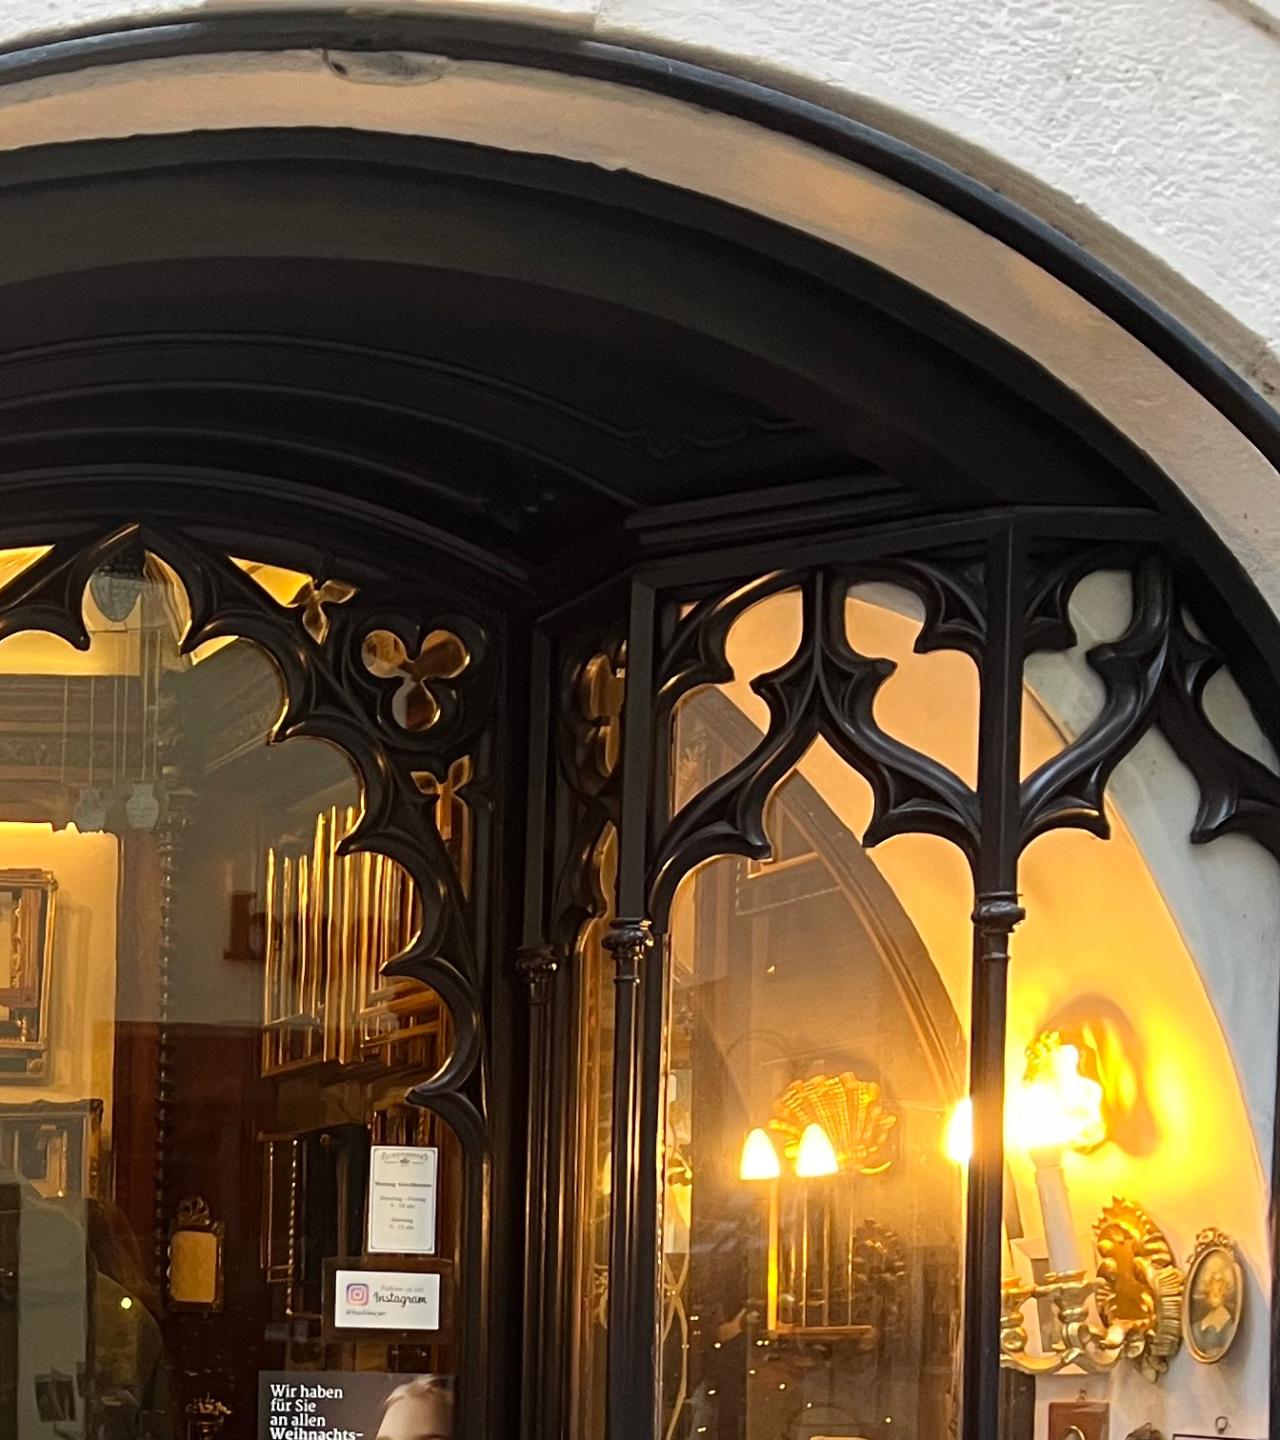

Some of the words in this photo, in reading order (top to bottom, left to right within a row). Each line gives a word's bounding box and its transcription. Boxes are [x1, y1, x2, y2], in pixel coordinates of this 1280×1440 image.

[373, 1292, 427, 1308] Instagram
[270, 1384, 297, 1398] Wir
[300, 1384, 343, 1399] haben
[271, 1398, 291, 1412] für
[295, 1399, 316, 1412] Sie
[270, 1415, 288, 1426] an
[291, 1413, 326, 1426] allen
